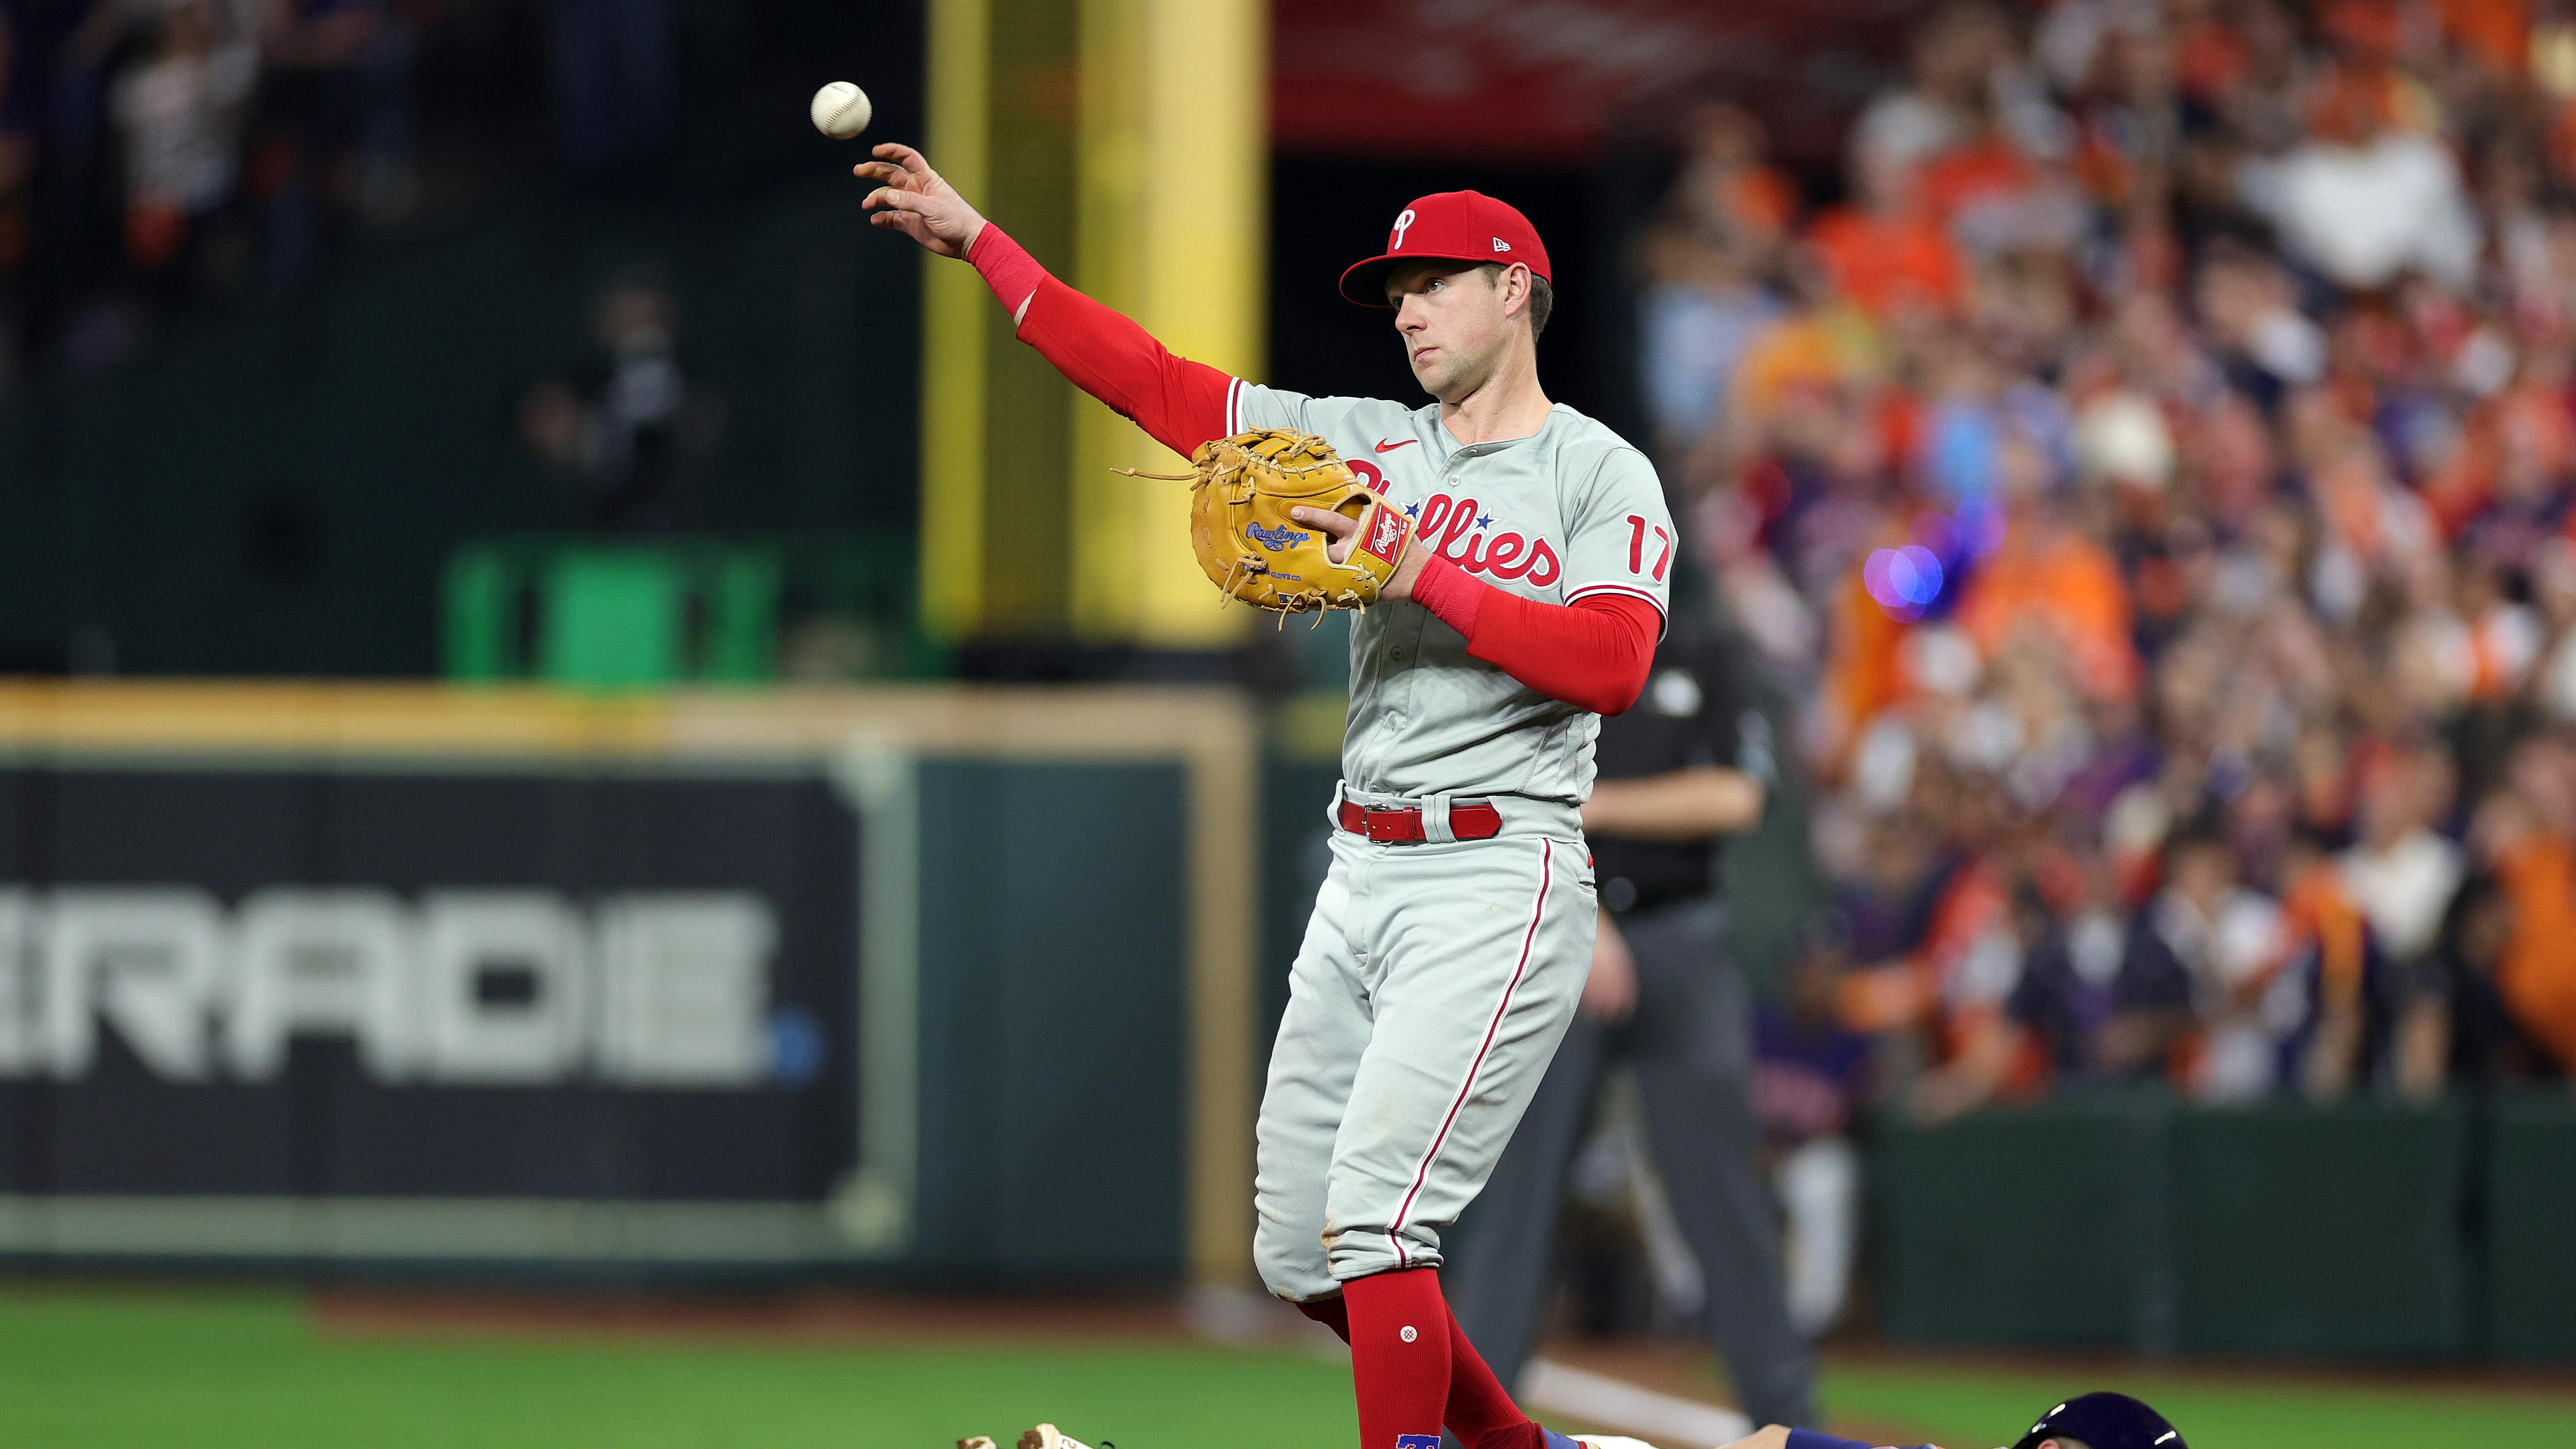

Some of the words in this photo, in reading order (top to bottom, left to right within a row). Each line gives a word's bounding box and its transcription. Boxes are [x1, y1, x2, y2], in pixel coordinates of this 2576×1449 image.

[1393, 209, 1416, 250] P
[1245, 521, 1311, 549] Rawlings
[1345, 458, 1563, 590] llies
[1375, 513, 1397, 553] Rawlings
[1624, 513, 1671, 585] 17
[0, 884, 780, 1085] RADE
